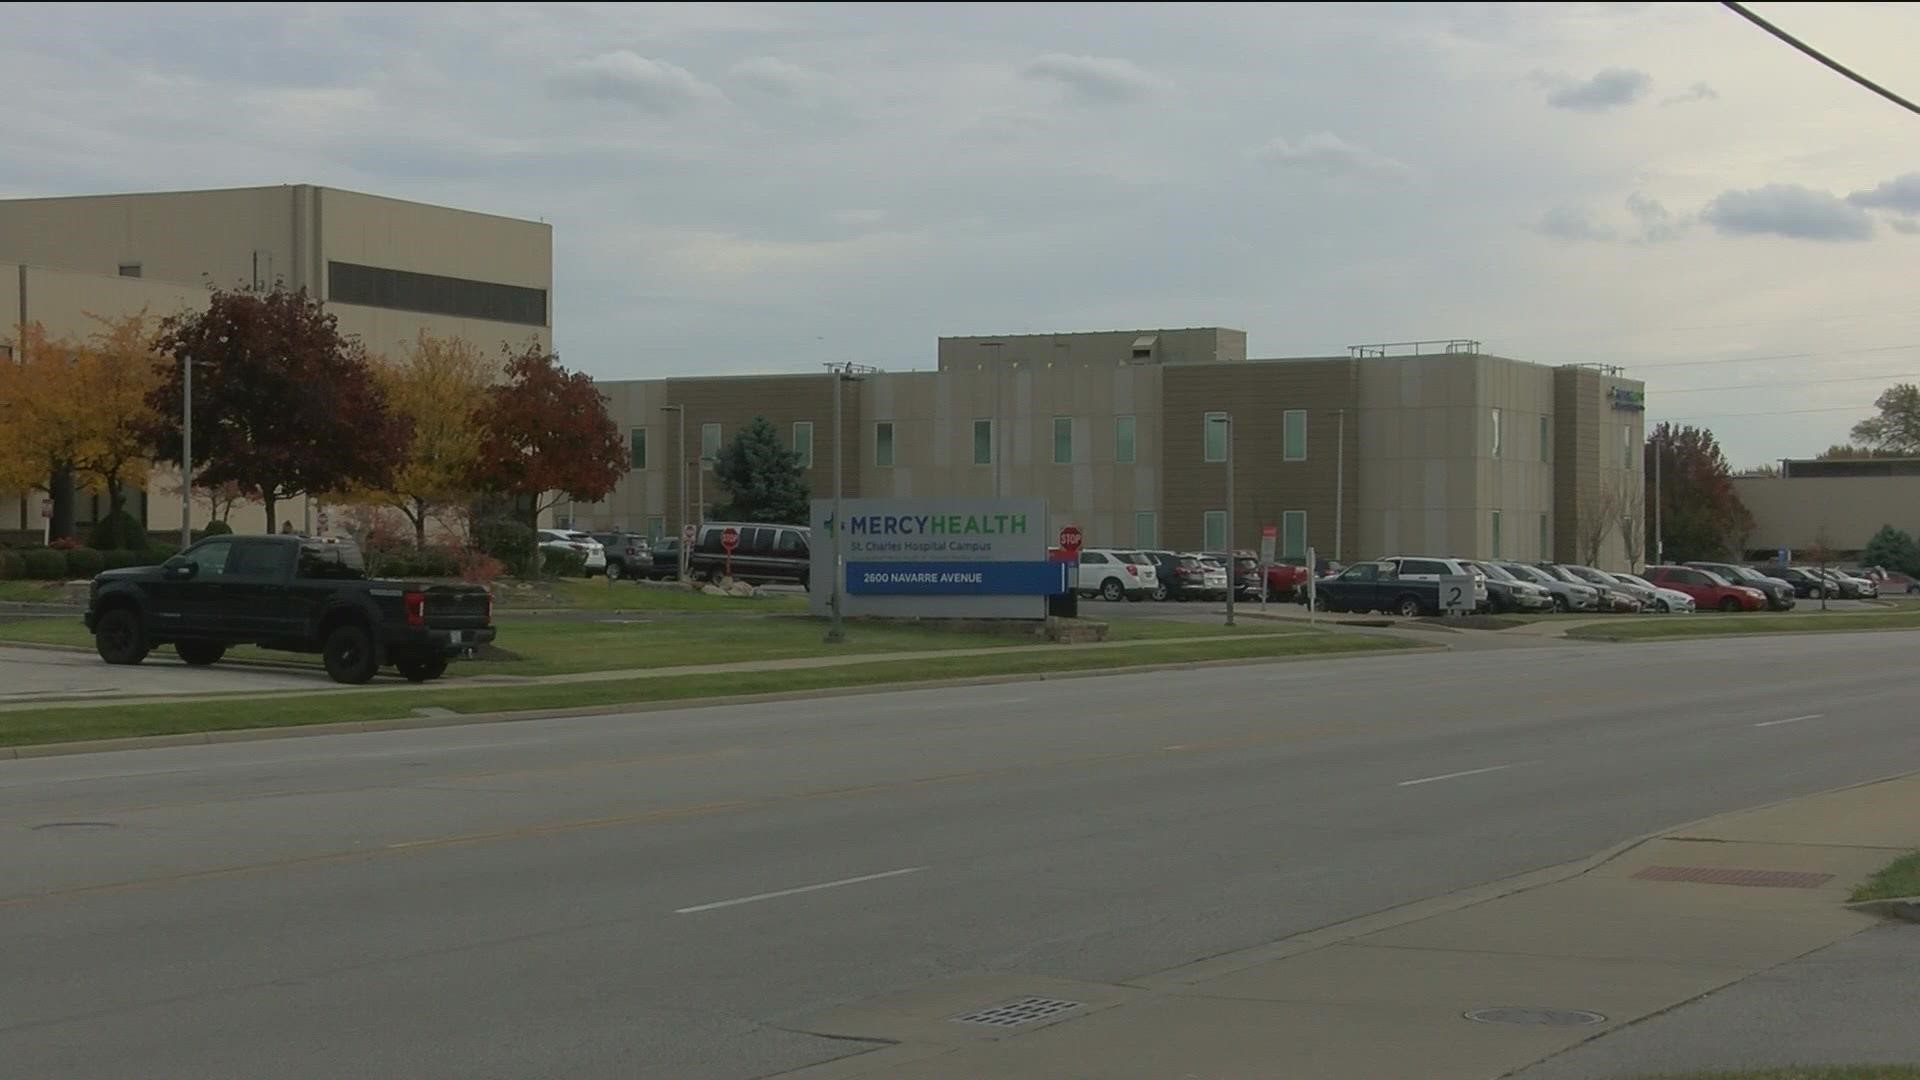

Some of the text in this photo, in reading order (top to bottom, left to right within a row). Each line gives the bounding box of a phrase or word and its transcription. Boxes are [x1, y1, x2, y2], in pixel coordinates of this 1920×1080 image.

[851, 515, 1026, 534] MERCYHEALTH
[1061, 534, 1080, 544] STOP
[851, 541, 991, 553] St. Charles Hospital Campus
[864, 573, 982, 583] 2600 NAVARRE AVENUE
[1447, 587, 1461, 606] 2
